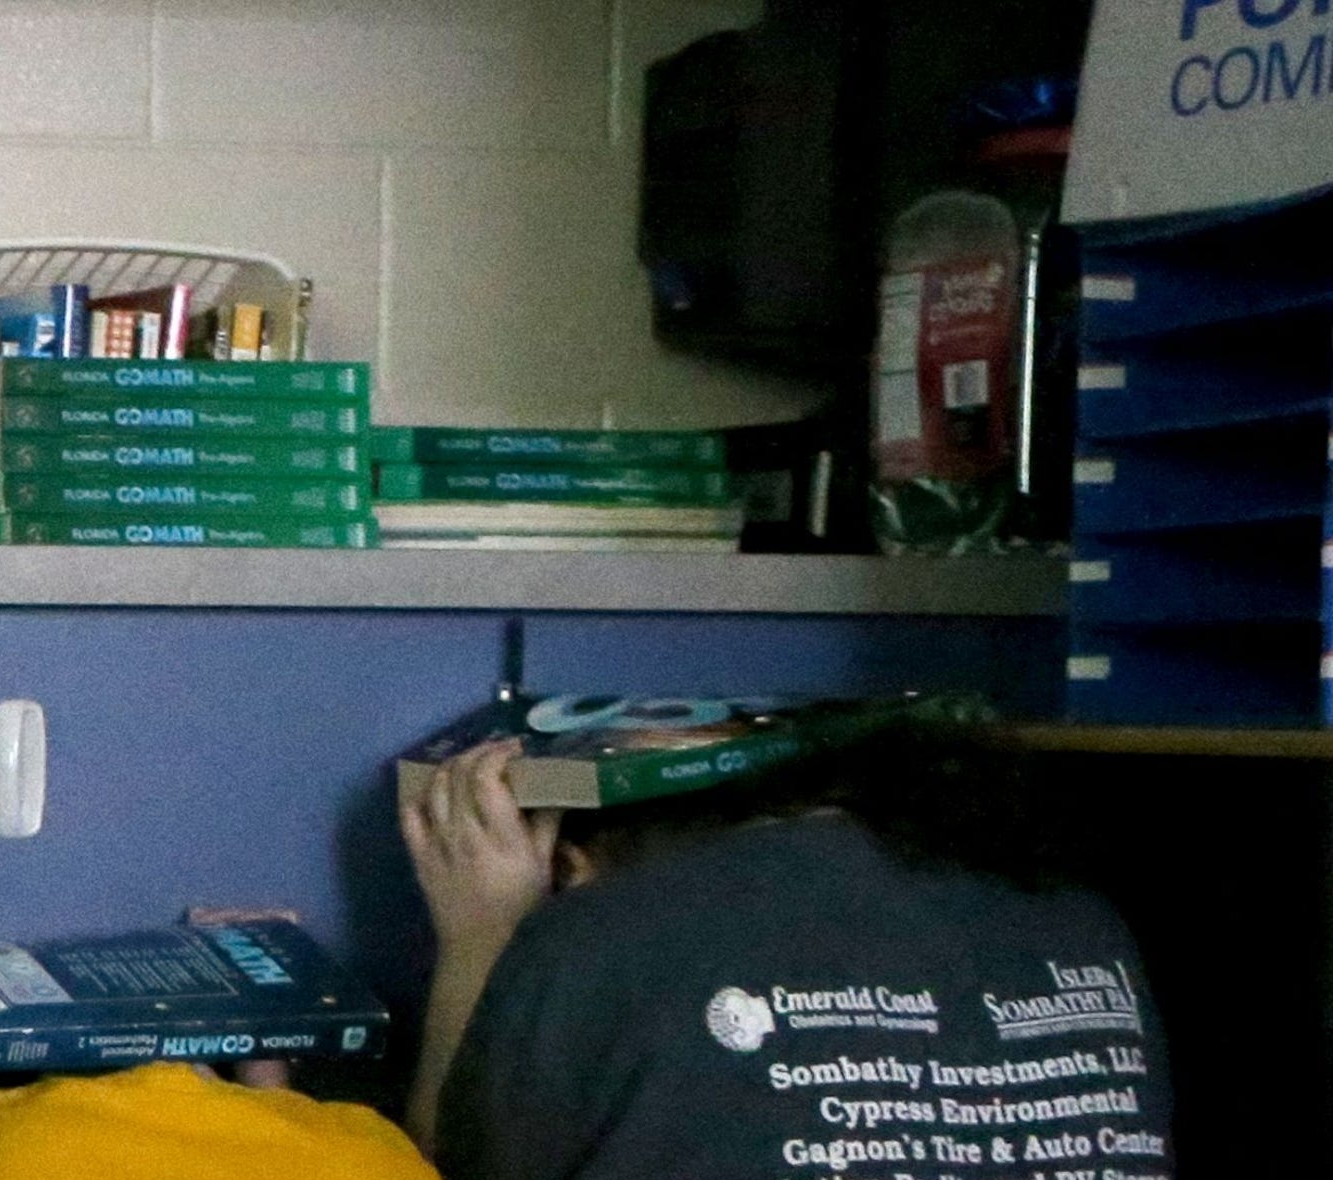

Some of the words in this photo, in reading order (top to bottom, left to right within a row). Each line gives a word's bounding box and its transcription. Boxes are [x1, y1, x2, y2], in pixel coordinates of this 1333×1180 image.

[1171, 35, 1333, 116] COM
[771, 985, 876, 1014] Emerald
[983, 990, 1106, 1024] SOMBATHY
[262, 1034, 315, 1049] FLORIDA
[769, 1055, 923, 1090] Sombathy
[928, 1051, 1108, 1086] Investments,
[1107, 1047, 1147, 1075] LLC
[820, 1096, 935, 1130] Cypress
[940, 1086, 1139, 1125] Environmental
[783, 1133, 926, 1170] Gagnon's
[930, 1135, 982, 1164] Tire
[991, 1136, 1015, 1164] &
[1023, 1132, 1092, 1161] Auto
[1097, 1126, 1165, 1156] Center
